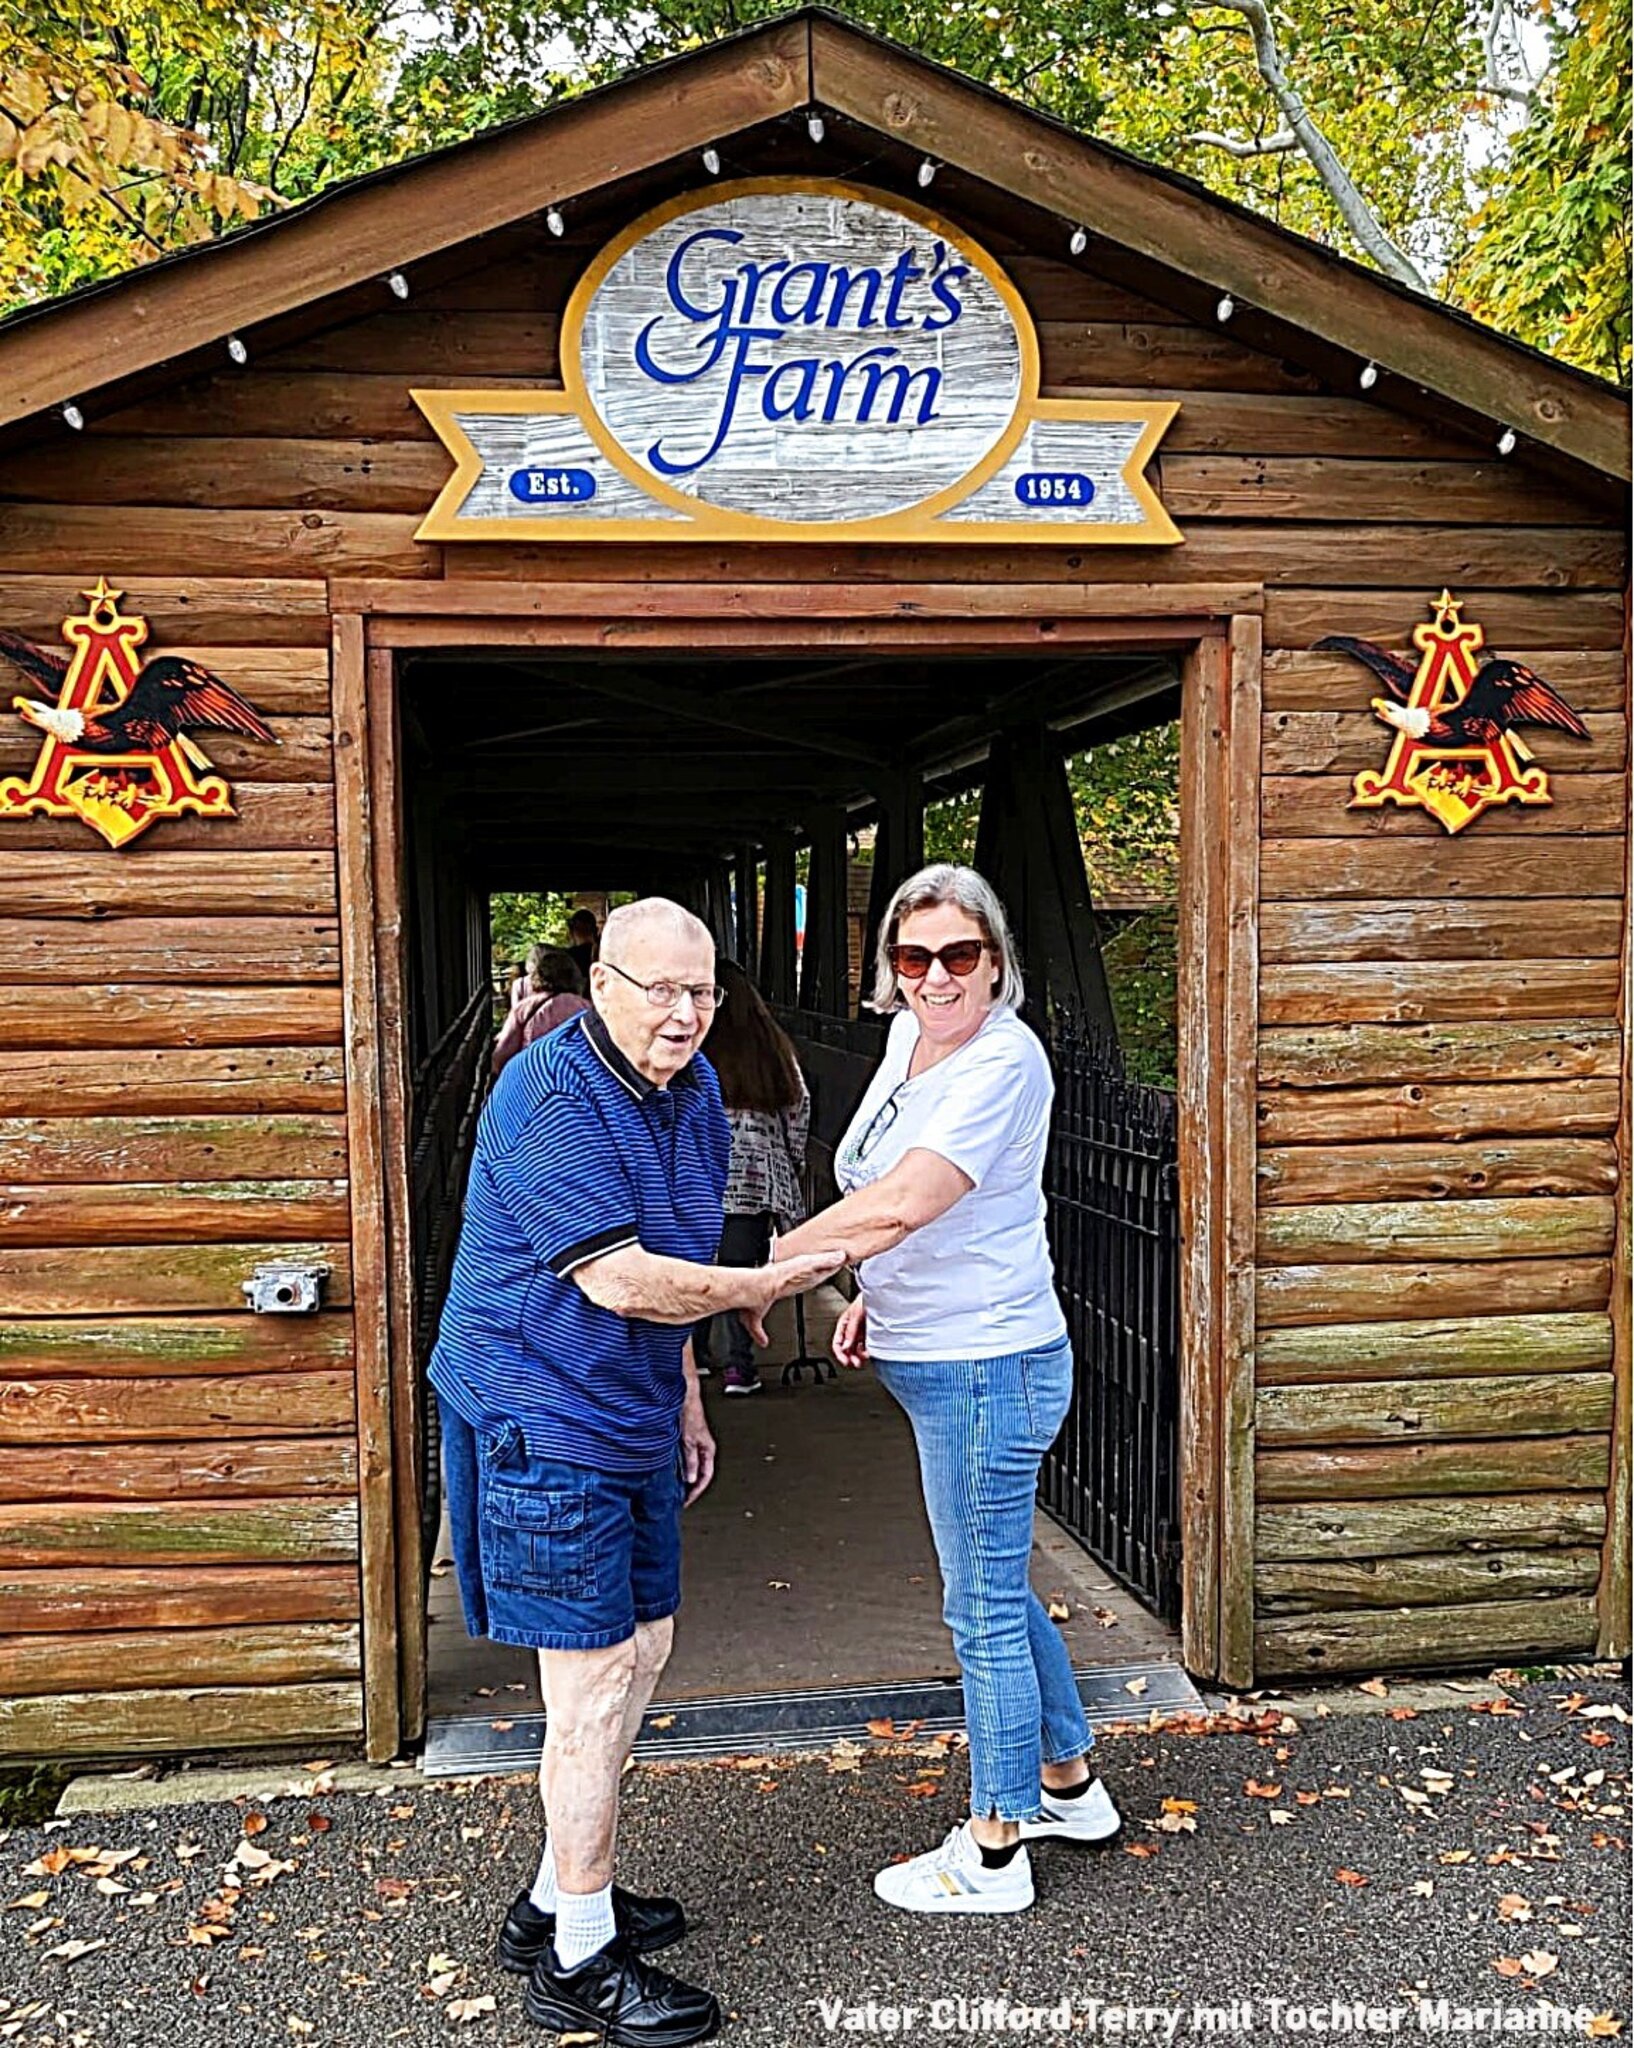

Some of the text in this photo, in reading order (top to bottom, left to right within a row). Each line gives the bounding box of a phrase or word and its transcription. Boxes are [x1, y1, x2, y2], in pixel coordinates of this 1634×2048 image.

[635, 229, 971, 384] Grant's
[647, 327, 943, 475] Farm
[527, 471, 580, 496] Est.
[1027, 478, 1082, 500] 1954
